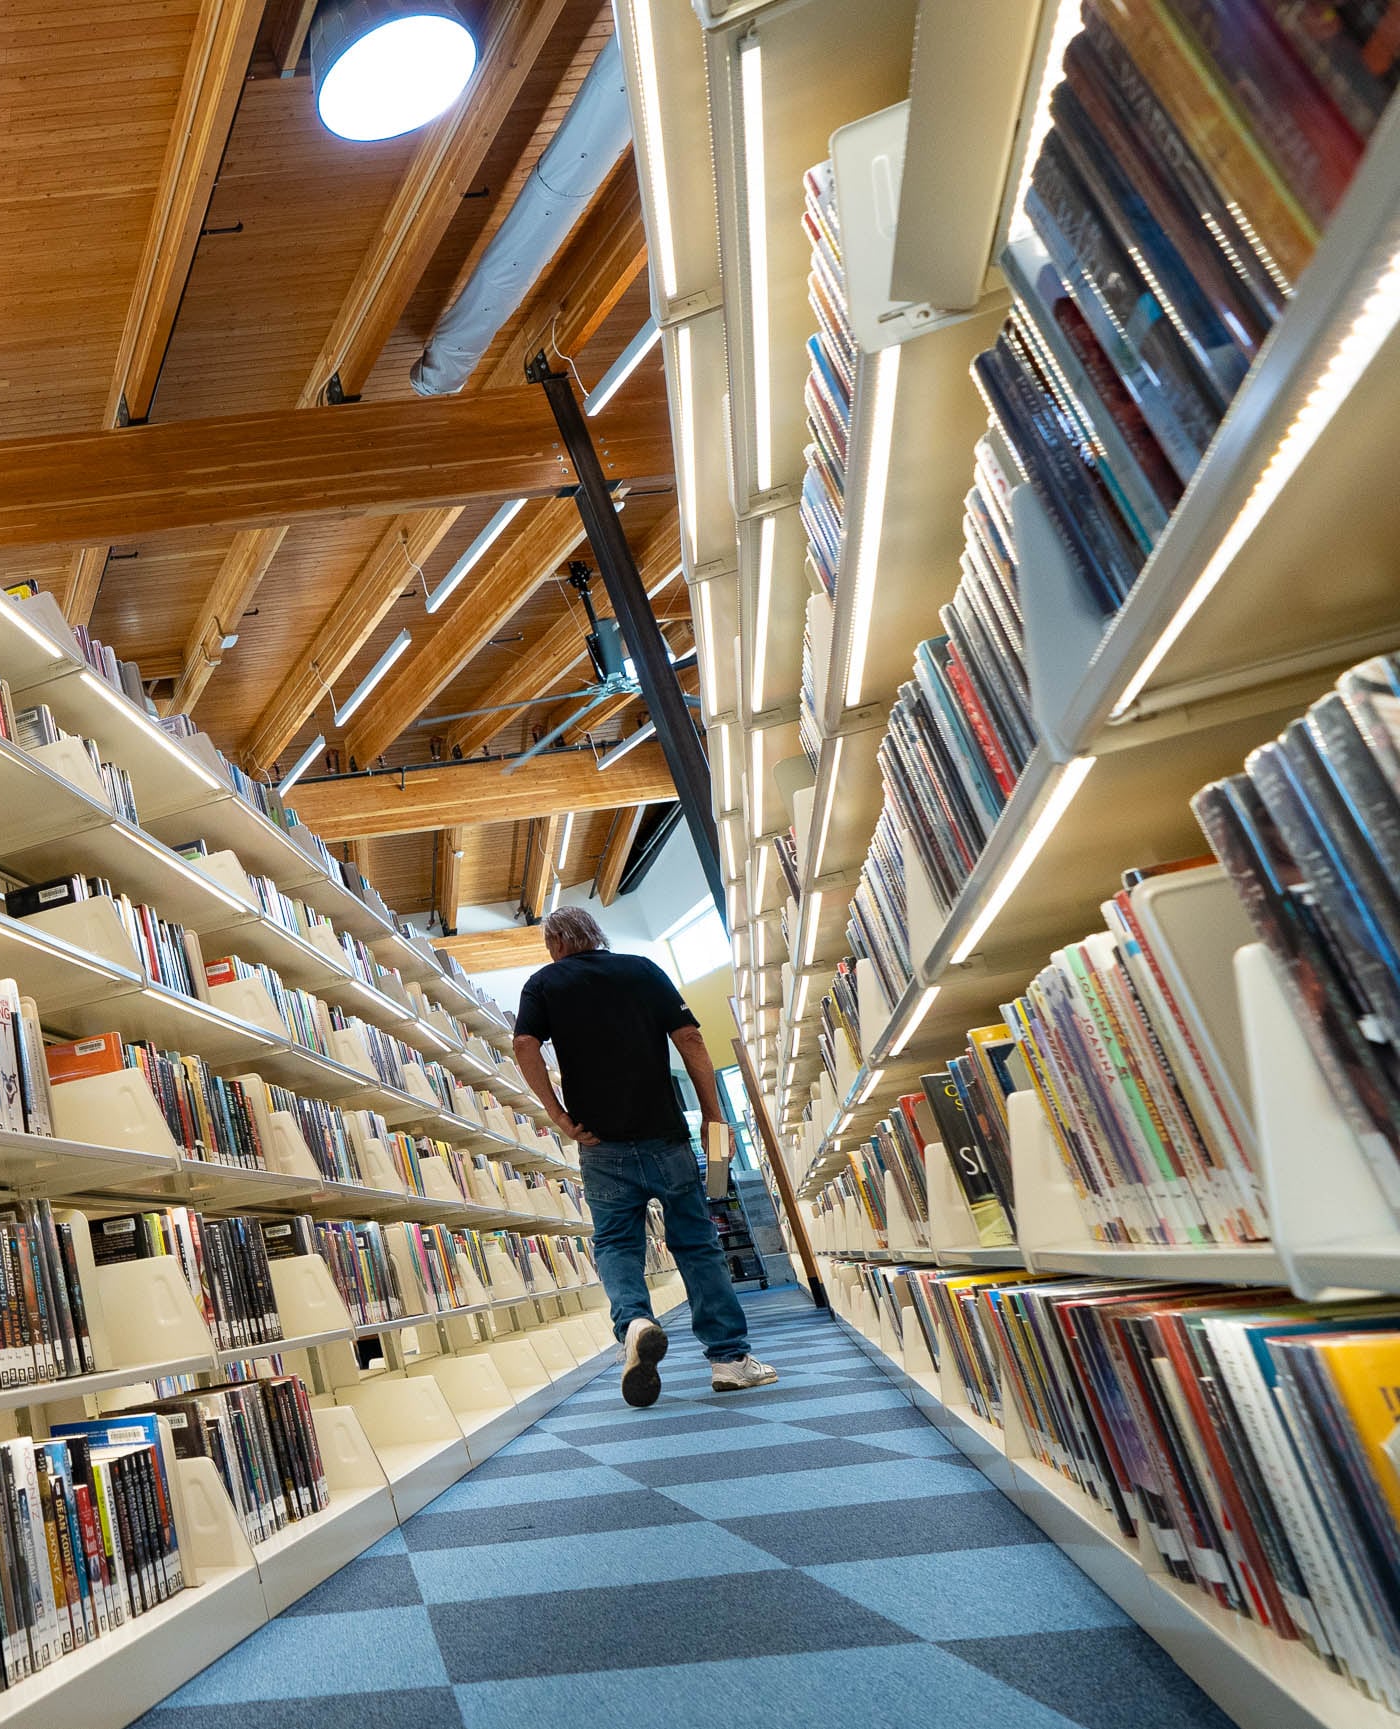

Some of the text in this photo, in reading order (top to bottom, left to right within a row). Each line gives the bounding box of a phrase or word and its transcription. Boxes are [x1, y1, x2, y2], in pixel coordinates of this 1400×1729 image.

[1079, 976, 1113, 1045] JOANNA
[1082, 1017, 1117, 1085] JOANNA
[2, 1229, 16, 1297] STEPHEN KING
[33, 1255, 43, 1293] STEPHEN
[24, 1448, 40, 1521] KOONTZ
[47, 1522, 61, 1584] KOONTZ
[55, 1499, 74, 1580] DEAN KOONTZ
[106, 1485, 123, 1561] DEAN KOONTZ
